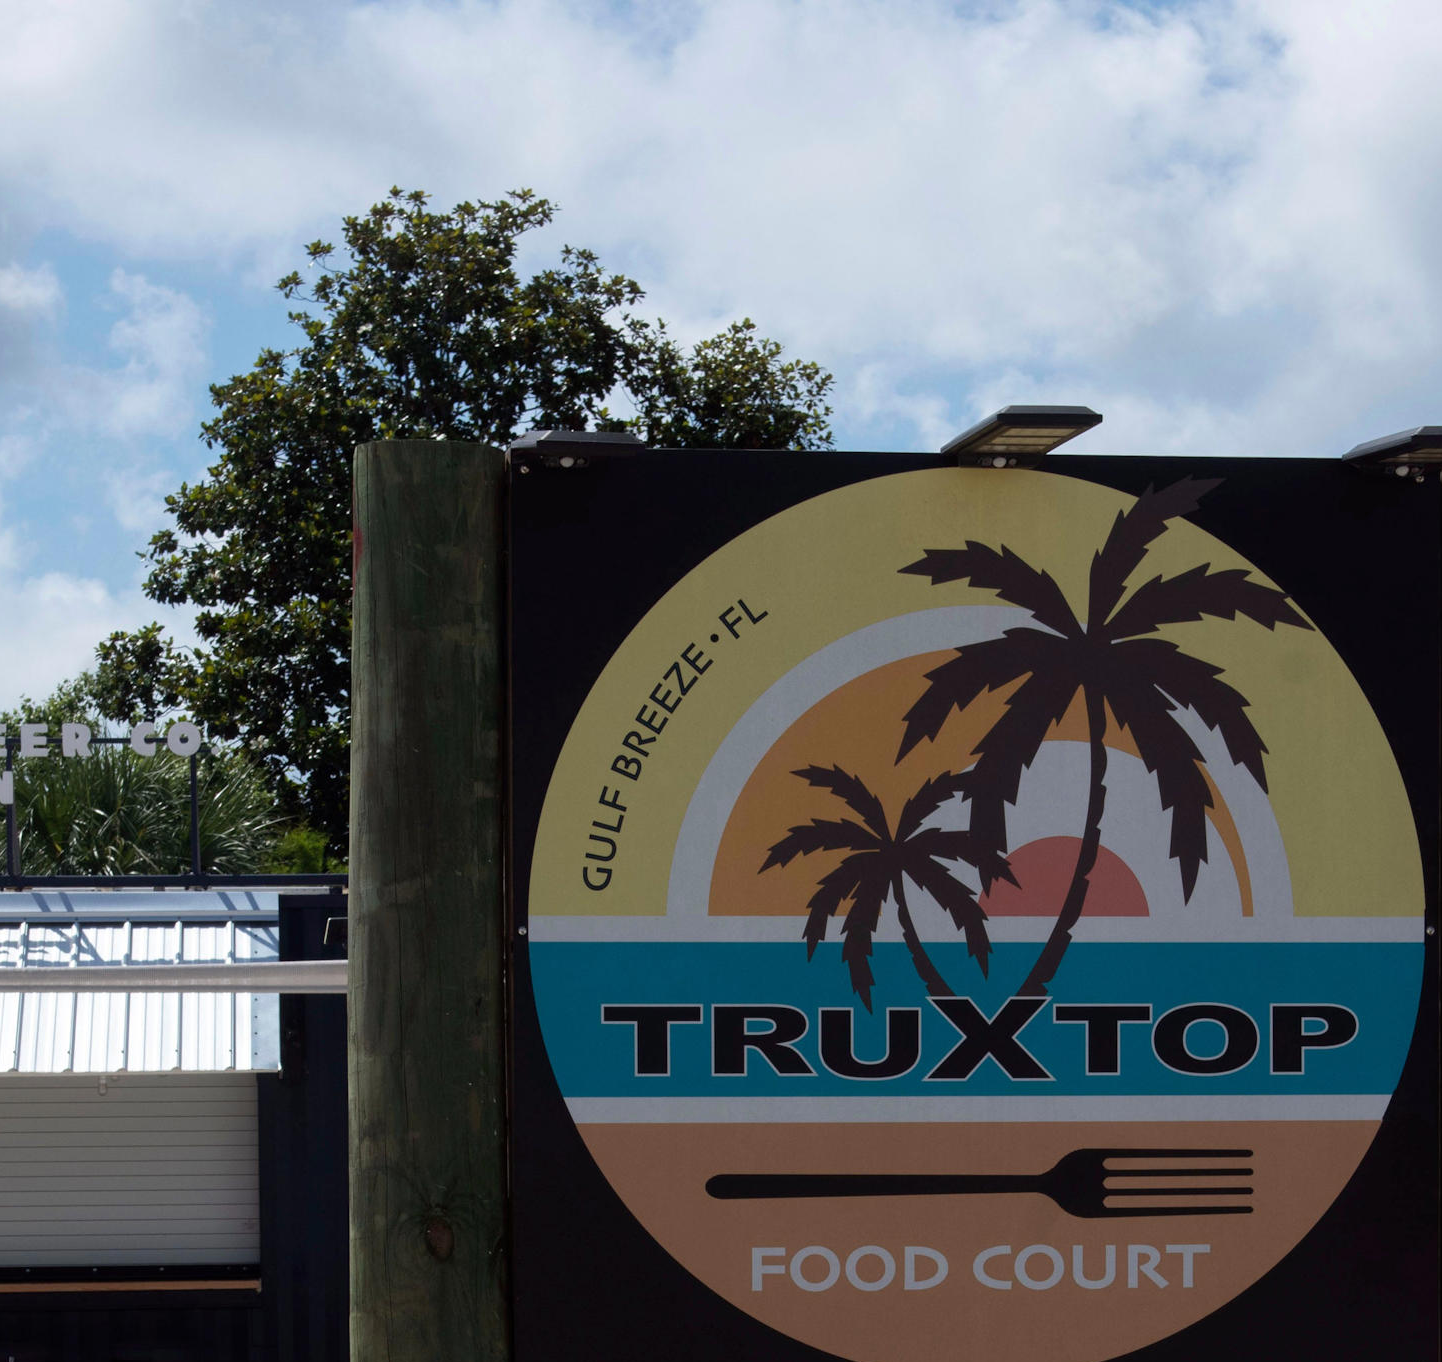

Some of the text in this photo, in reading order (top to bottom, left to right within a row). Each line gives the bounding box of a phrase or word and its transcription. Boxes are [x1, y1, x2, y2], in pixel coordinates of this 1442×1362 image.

[130, 720, 222, 758] CO.
[582, 599, 769, 891] GULF BREEZE FL
[600, 996, 1359, 1081] TRUXTOP
[750, 1243, 1211, 1292] FOOD COURT
